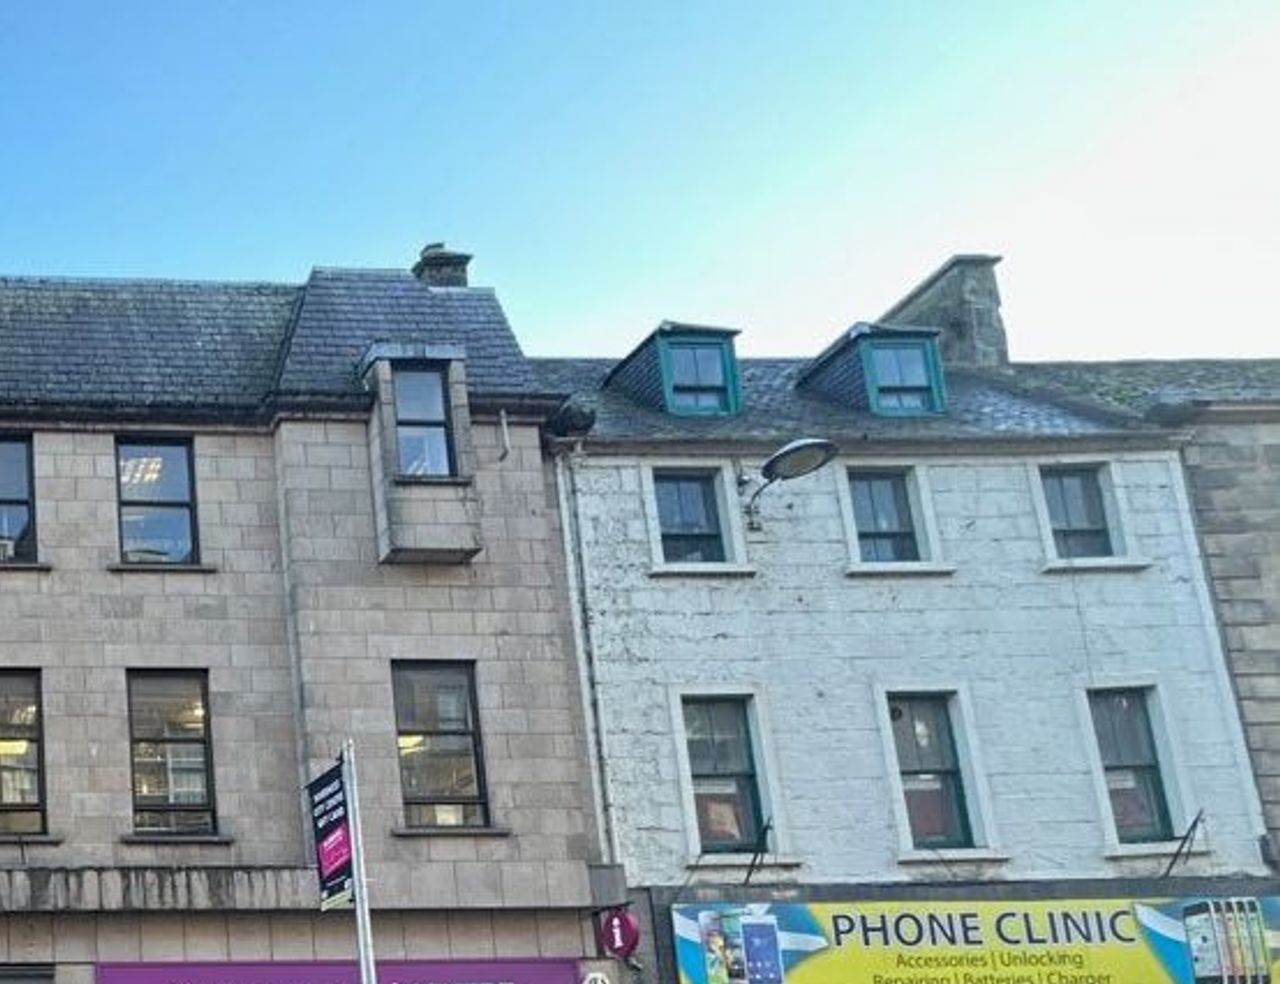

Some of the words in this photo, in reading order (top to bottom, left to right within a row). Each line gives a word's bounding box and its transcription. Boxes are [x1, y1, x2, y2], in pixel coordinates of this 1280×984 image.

[831, 912, 984, 946] PHONE
[995, 909, 1136, 944] CLINIC
[896, 953, 988, 969] Accessories
[1000, 950, 1084, 969] Unlocking
